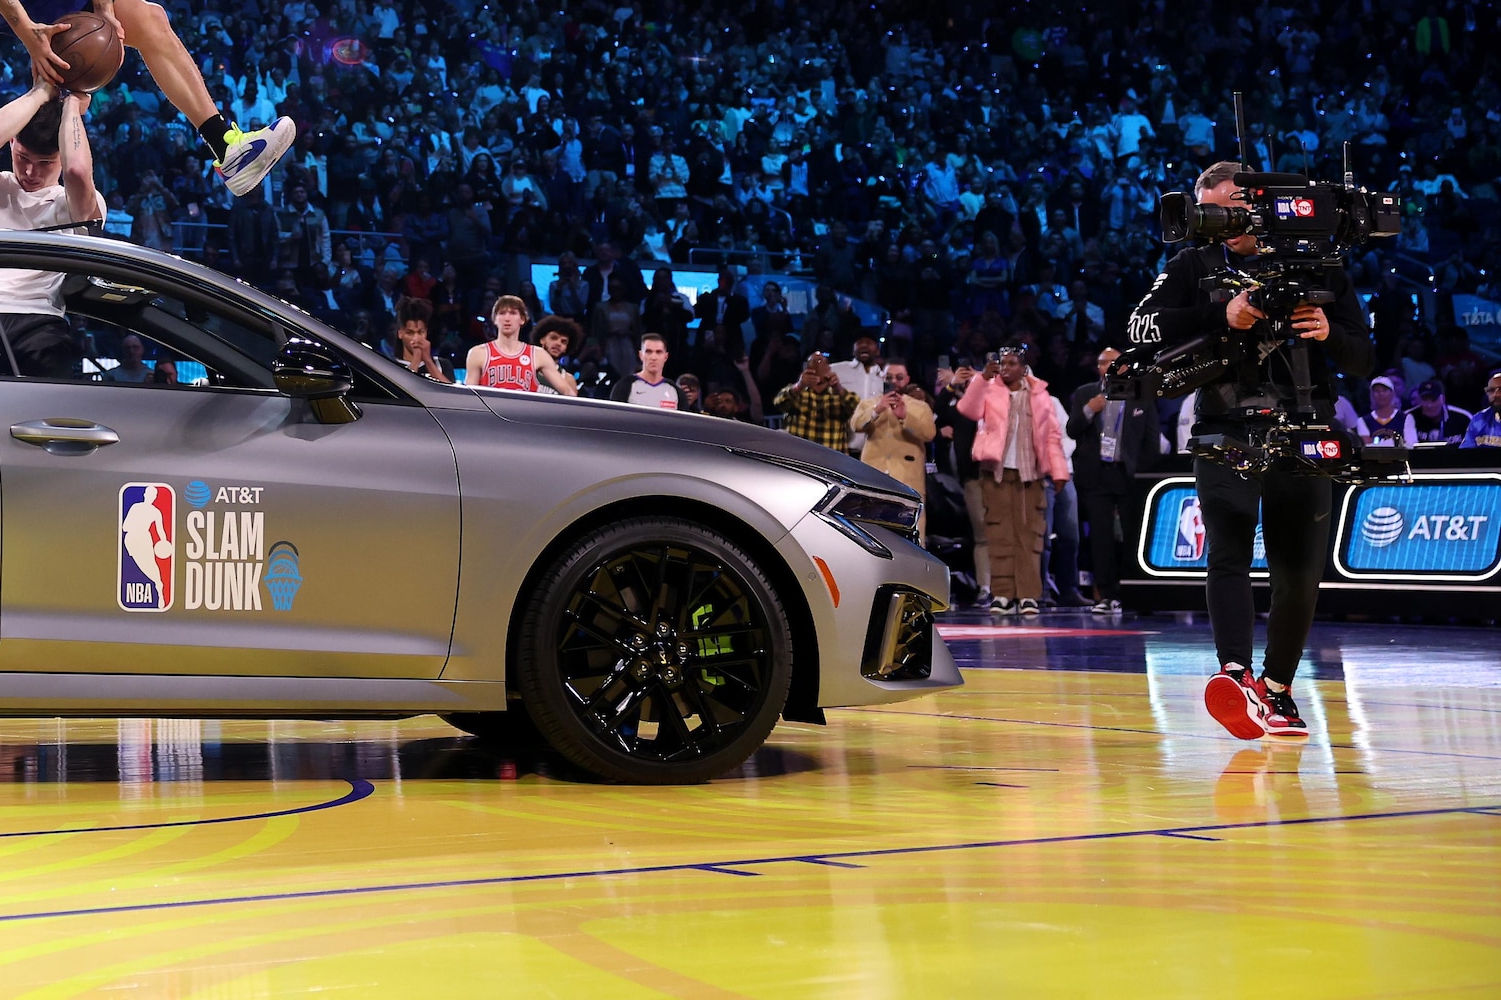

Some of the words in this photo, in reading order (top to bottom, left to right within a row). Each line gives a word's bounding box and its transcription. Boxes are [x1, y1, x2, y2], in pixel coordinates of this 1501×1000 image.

[1128, 312, 1162, 343] 025
[488, 365, 533, 391] BULLS
[215, 486, 264, 504] AT&T
[187, 511, 264, 561] SLAM
[1408, 515, 1488, 541] AT&T
[125, 582, 153, 604] NBA
[185, 561, 262, 611] DUNK
